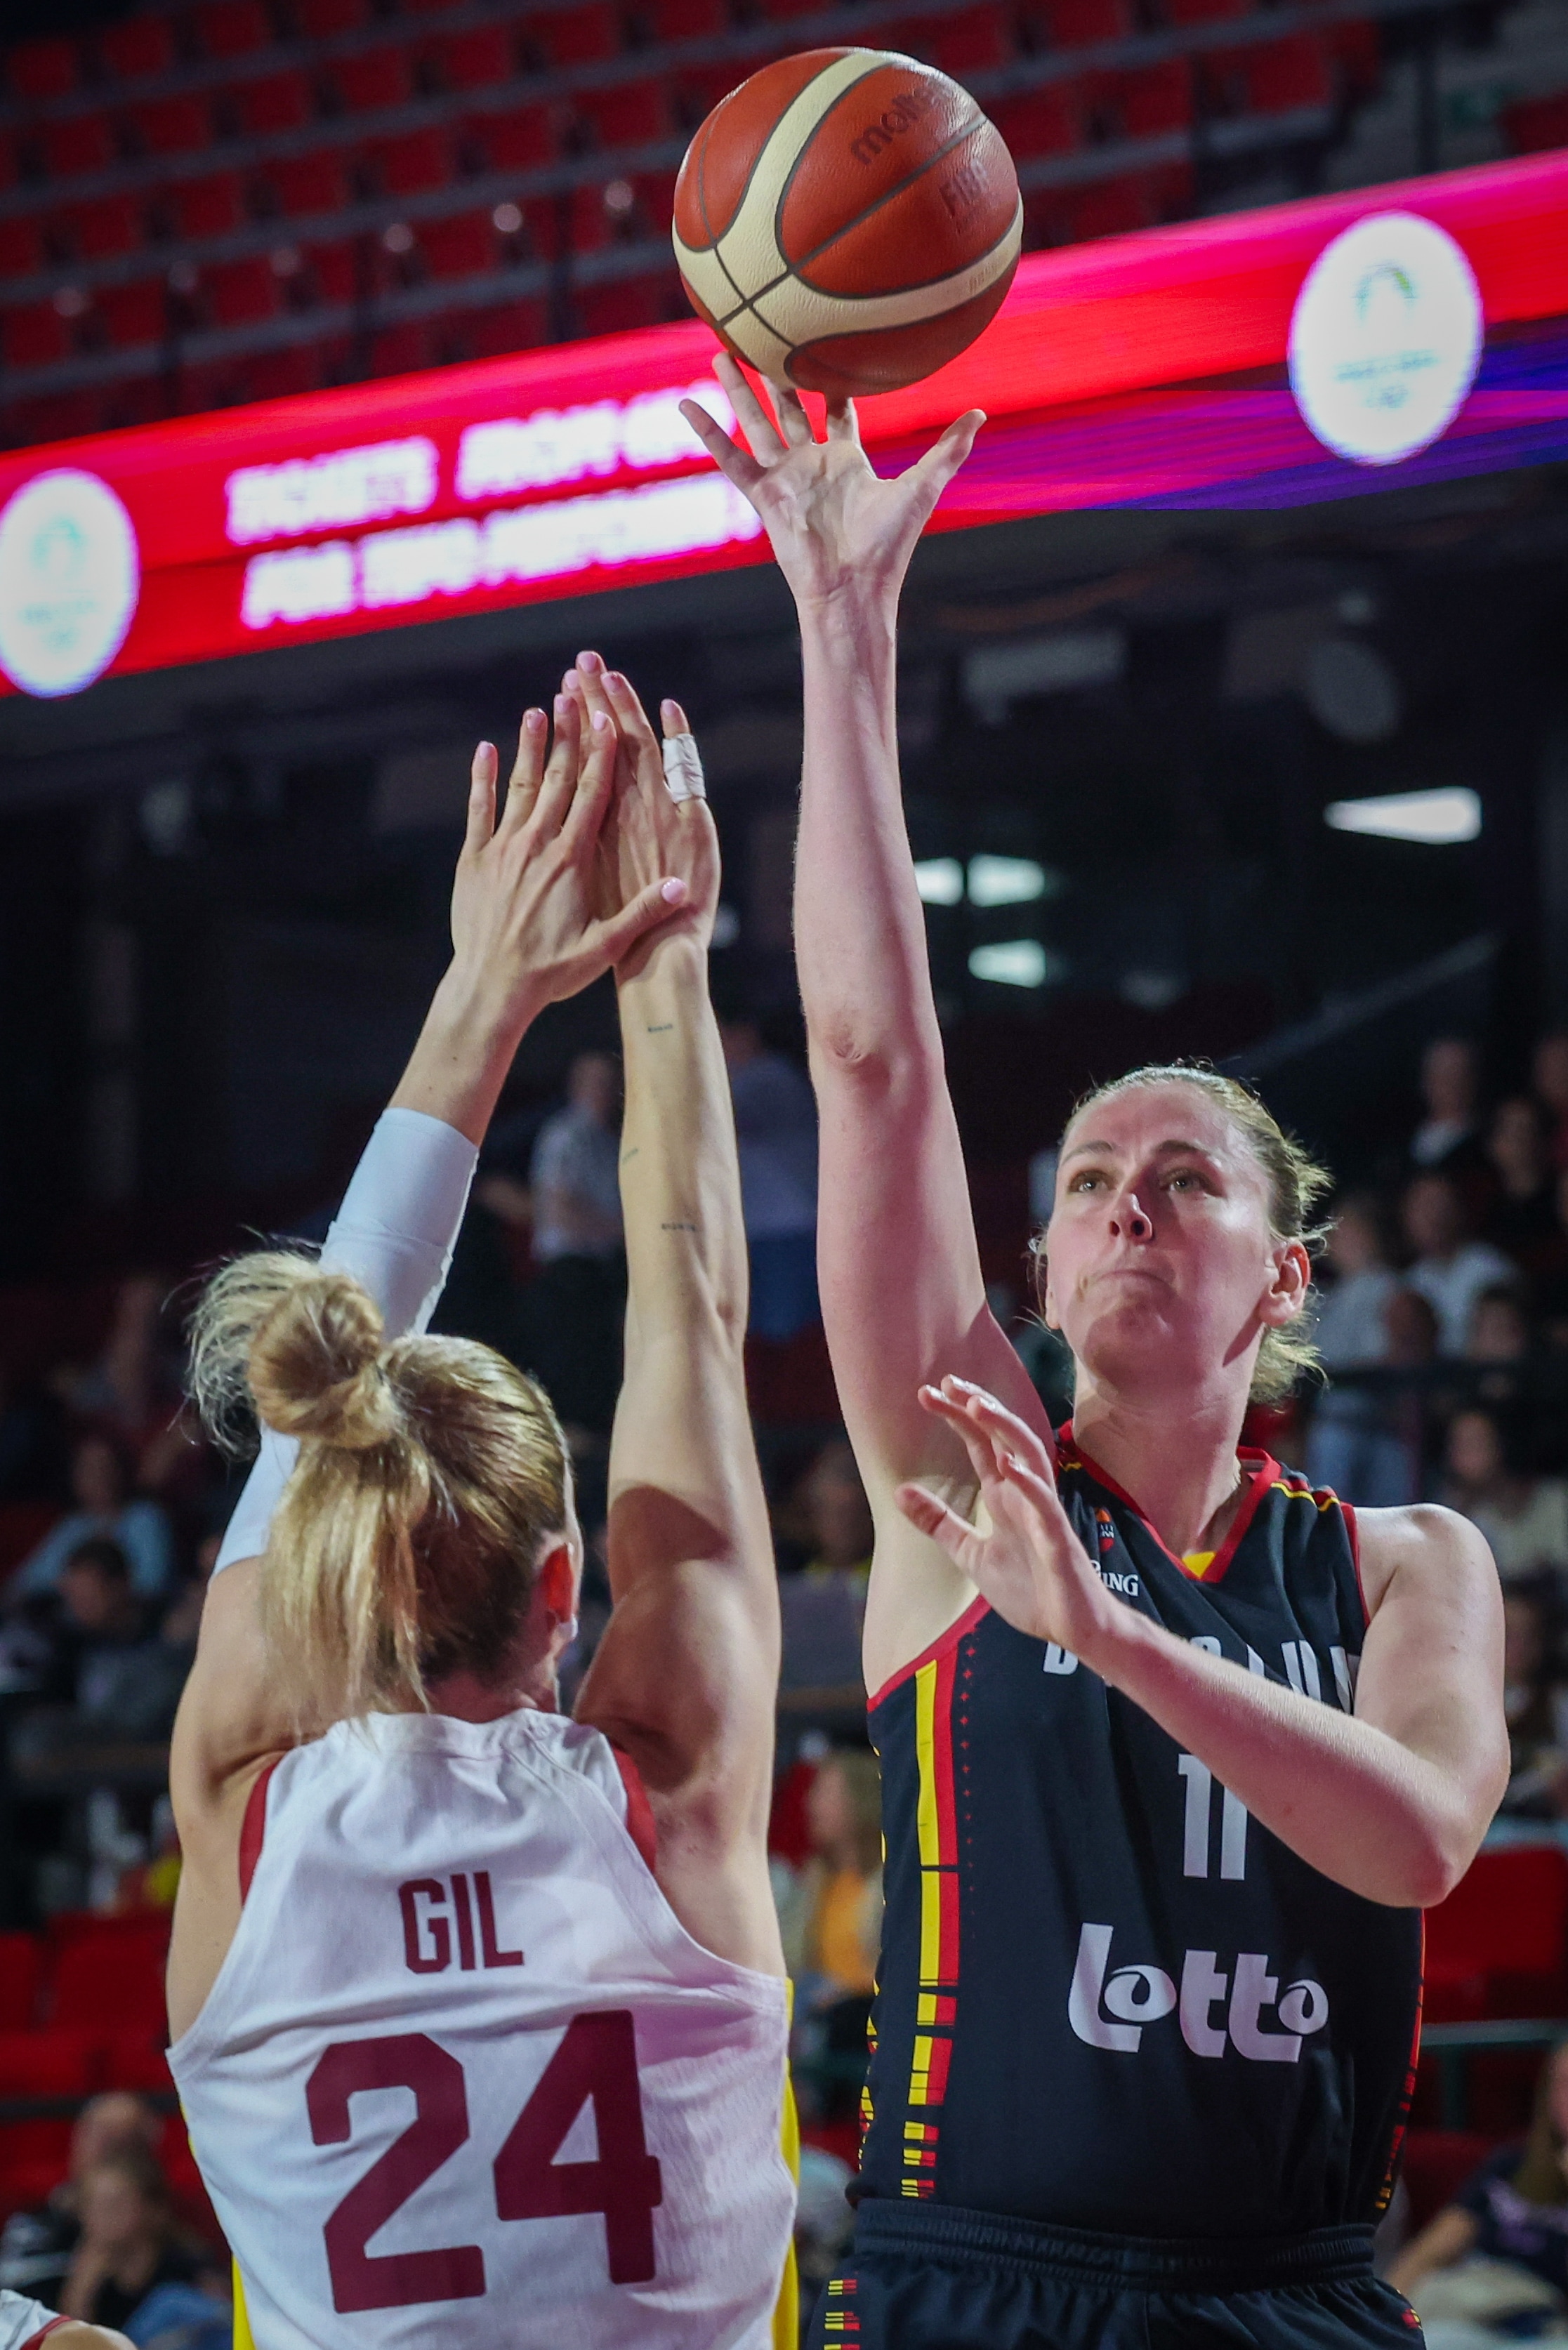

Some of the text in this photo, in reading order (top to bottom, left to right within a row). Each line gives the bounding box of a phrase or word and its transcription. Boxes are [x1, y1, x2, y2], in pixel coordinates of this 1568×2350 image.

[1178, 1754, 1248, 1880] 11
[398, 1870, 524, 1974] GIL
[305, 2009, 662, 2313] 24
